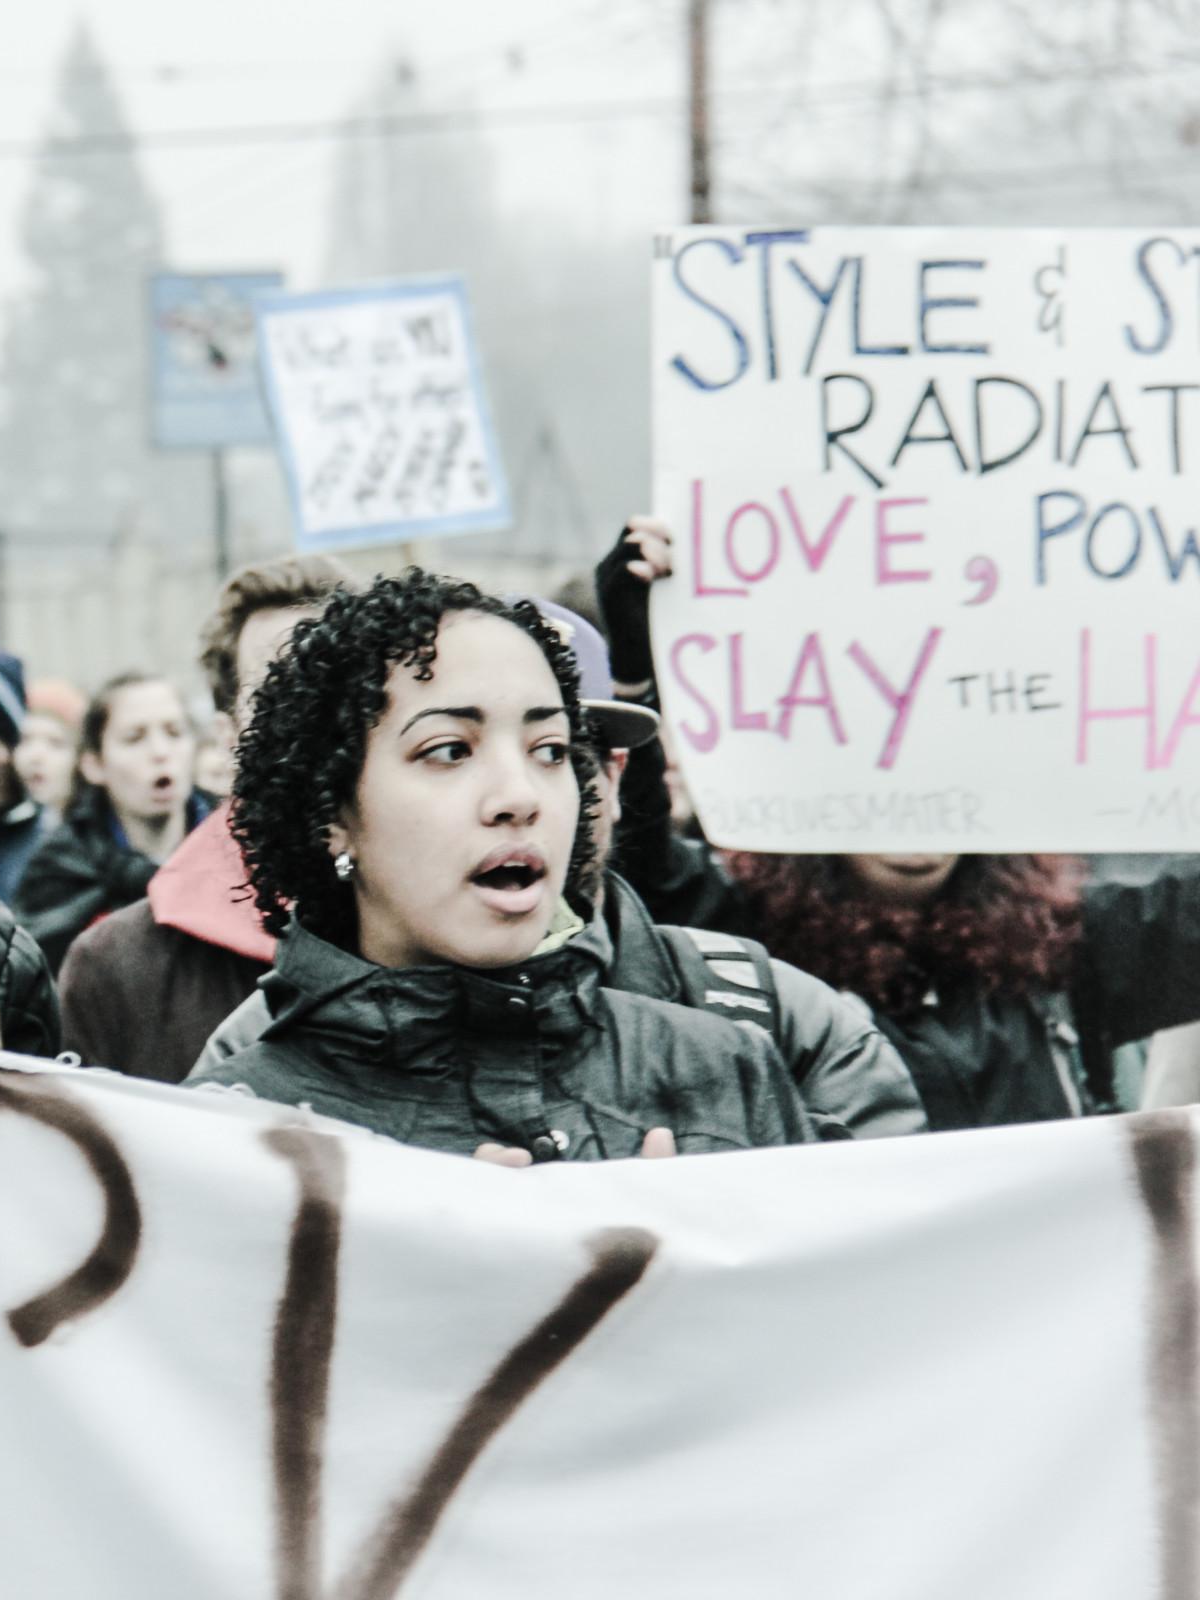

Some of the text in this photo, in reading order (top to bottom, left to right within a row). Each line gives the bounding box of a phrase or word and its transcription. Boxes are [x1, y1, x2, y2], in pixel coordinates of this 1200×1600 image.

[822, 373, 1200, 490] RADIAT
[669, 626, 944, 770] SLAY
[947, 672, 1063, 715] THE
